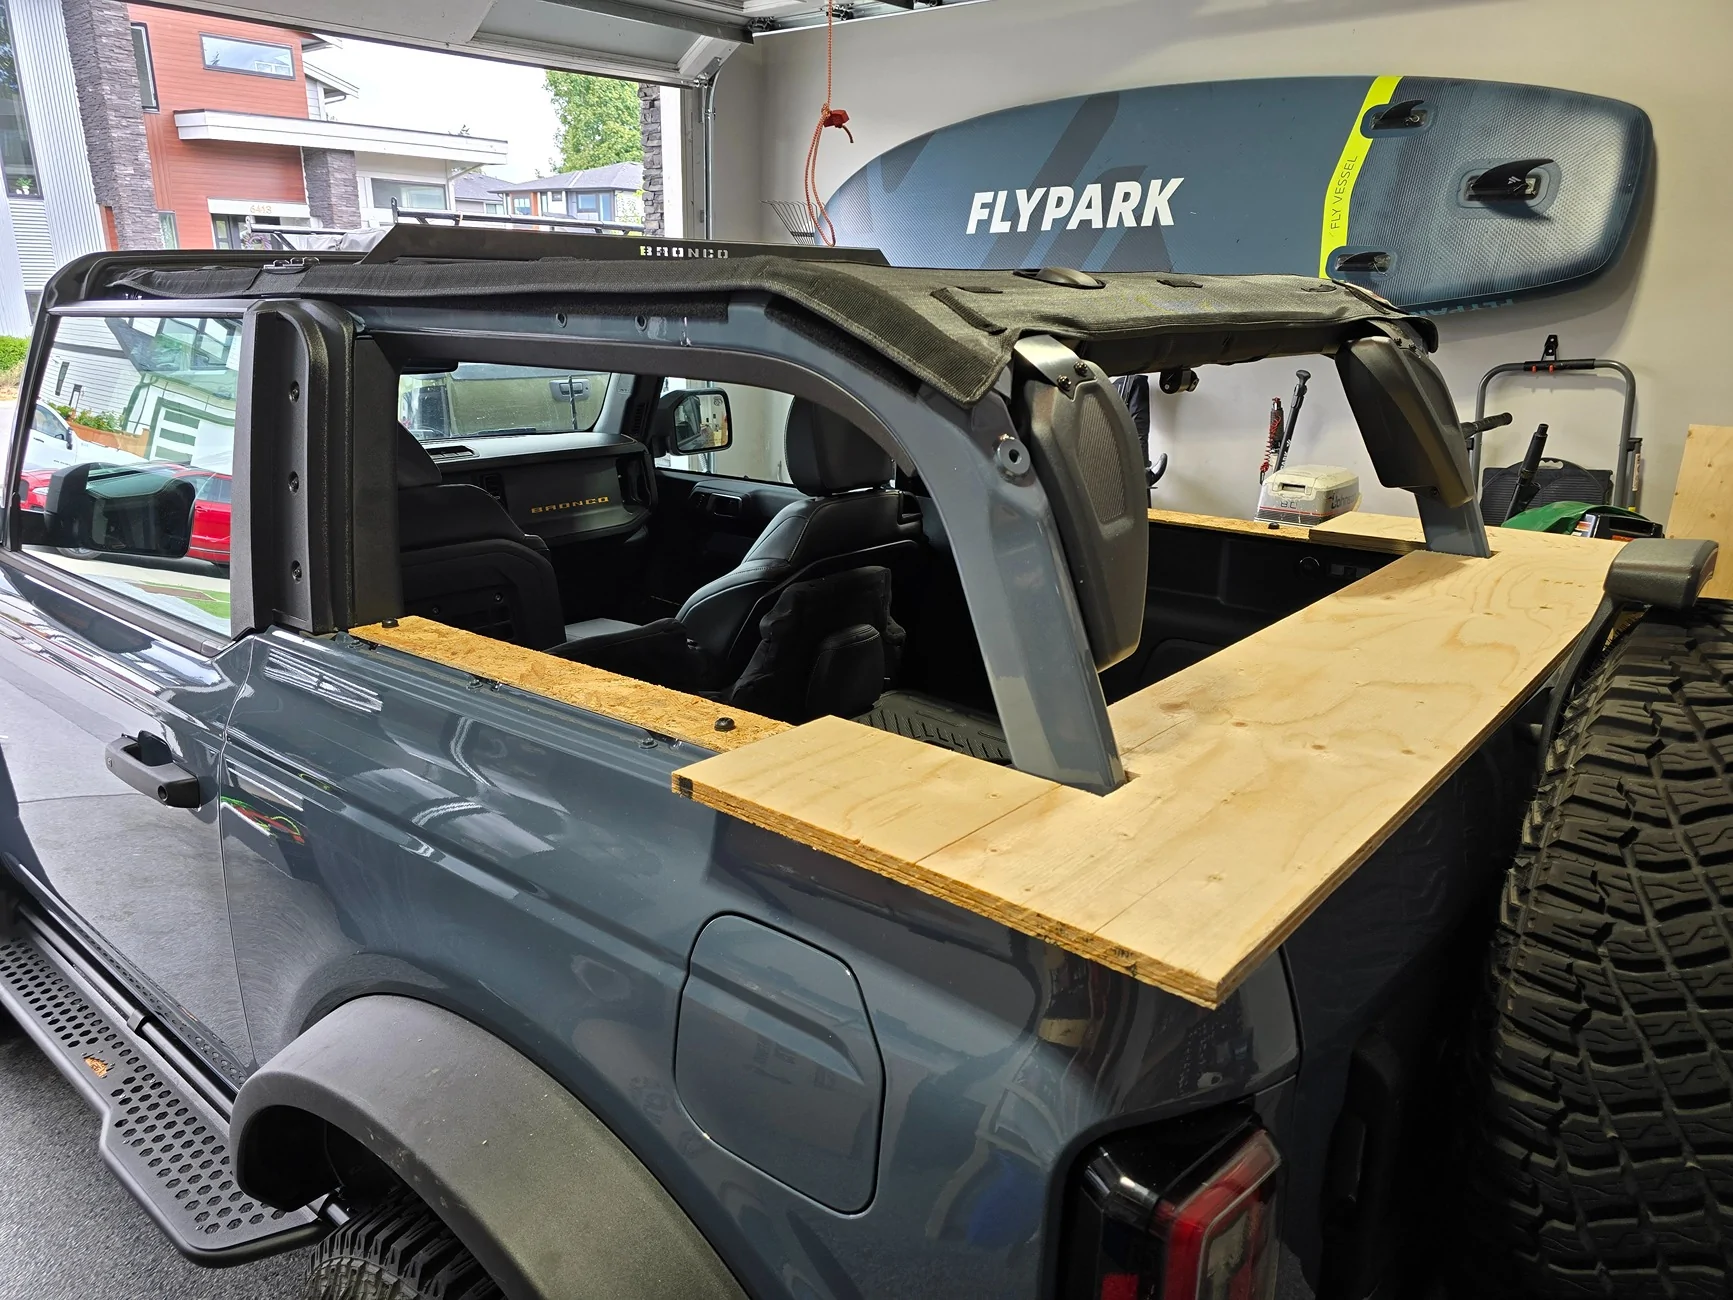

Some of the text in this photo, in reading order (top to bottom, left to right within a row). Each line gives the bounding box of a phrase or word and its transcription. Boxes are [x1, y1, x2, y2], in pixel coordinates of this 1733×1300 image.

[966, 178, 1185, 235] FLYPARK
[1330, 155, 1358, 230] FLY VESSEL
[640, 245, 729, 259] BRONCO
[531, 496, 609, 514] BRONCO
